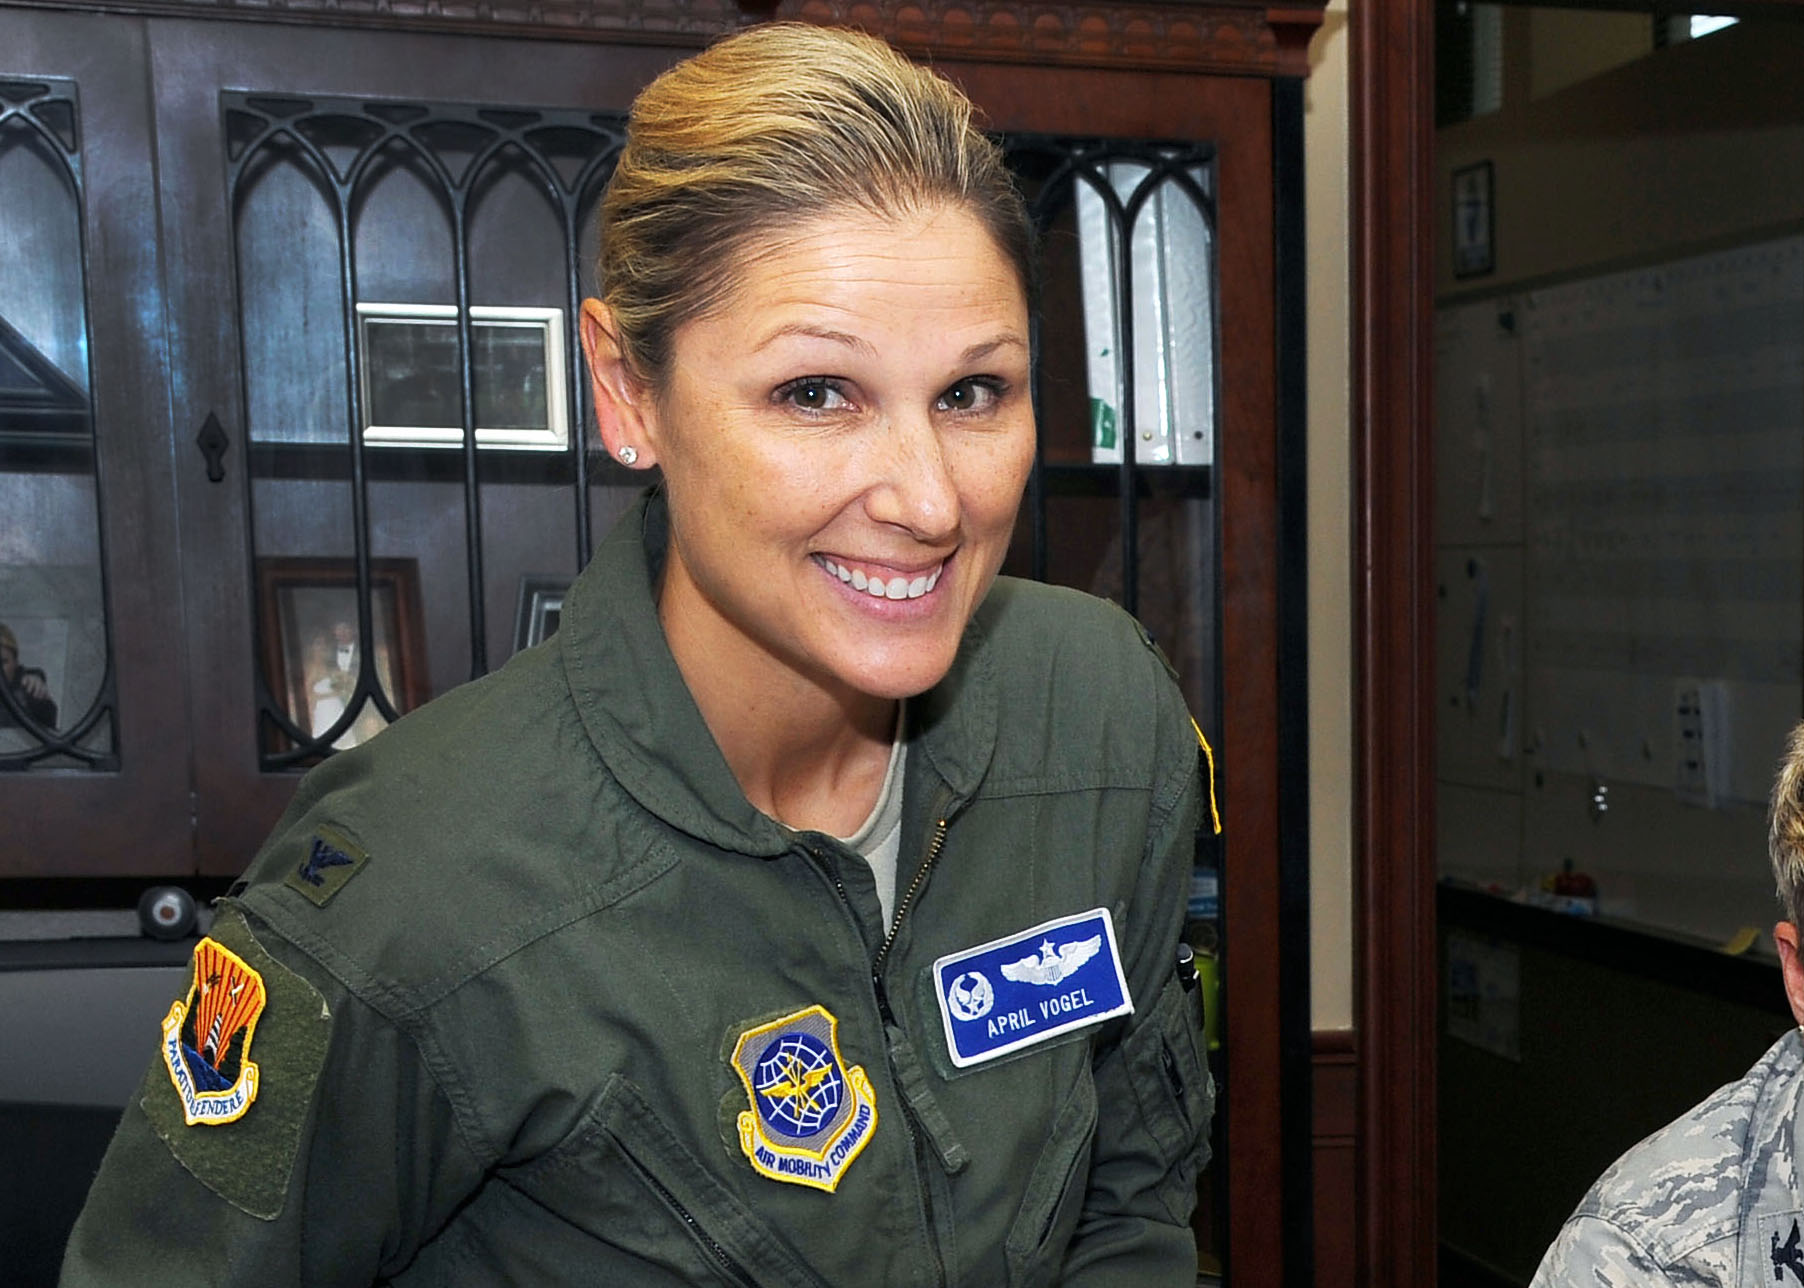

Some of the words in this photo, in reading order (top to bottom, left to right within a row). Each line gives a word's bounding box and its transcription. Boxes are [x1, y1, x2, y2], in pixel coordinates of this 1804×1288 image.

[987, 1008, 1036, 1038] APRIL
[1039, 988, 1095, 1020] VOGEL
[755, 1146, 776, 1169] AIR
[778, 1156, 832, 1180] MOBILITY
[830, 1104, 871, 1167] COMMAND
